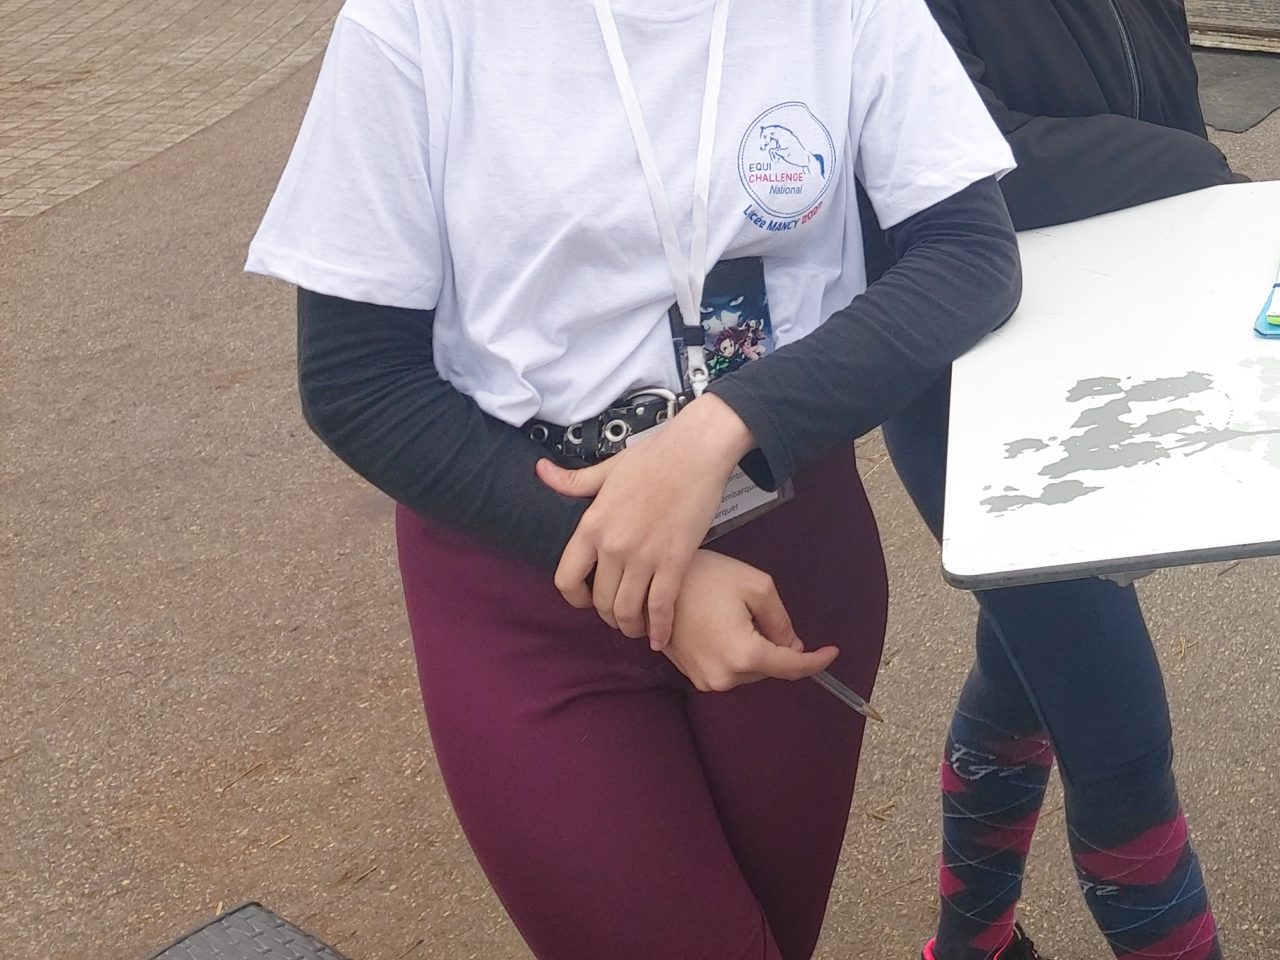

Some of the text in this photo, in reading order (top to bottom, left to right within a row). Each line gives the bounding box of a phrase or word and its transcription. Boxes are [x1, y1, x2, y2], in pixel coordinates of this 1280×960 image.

[748, 162, 772, 173] EQUI
[748, 172, 804, 184] CHALLENGE
[768, 184, 803, 195] National
[766, 219, 801, 232] MANCY
